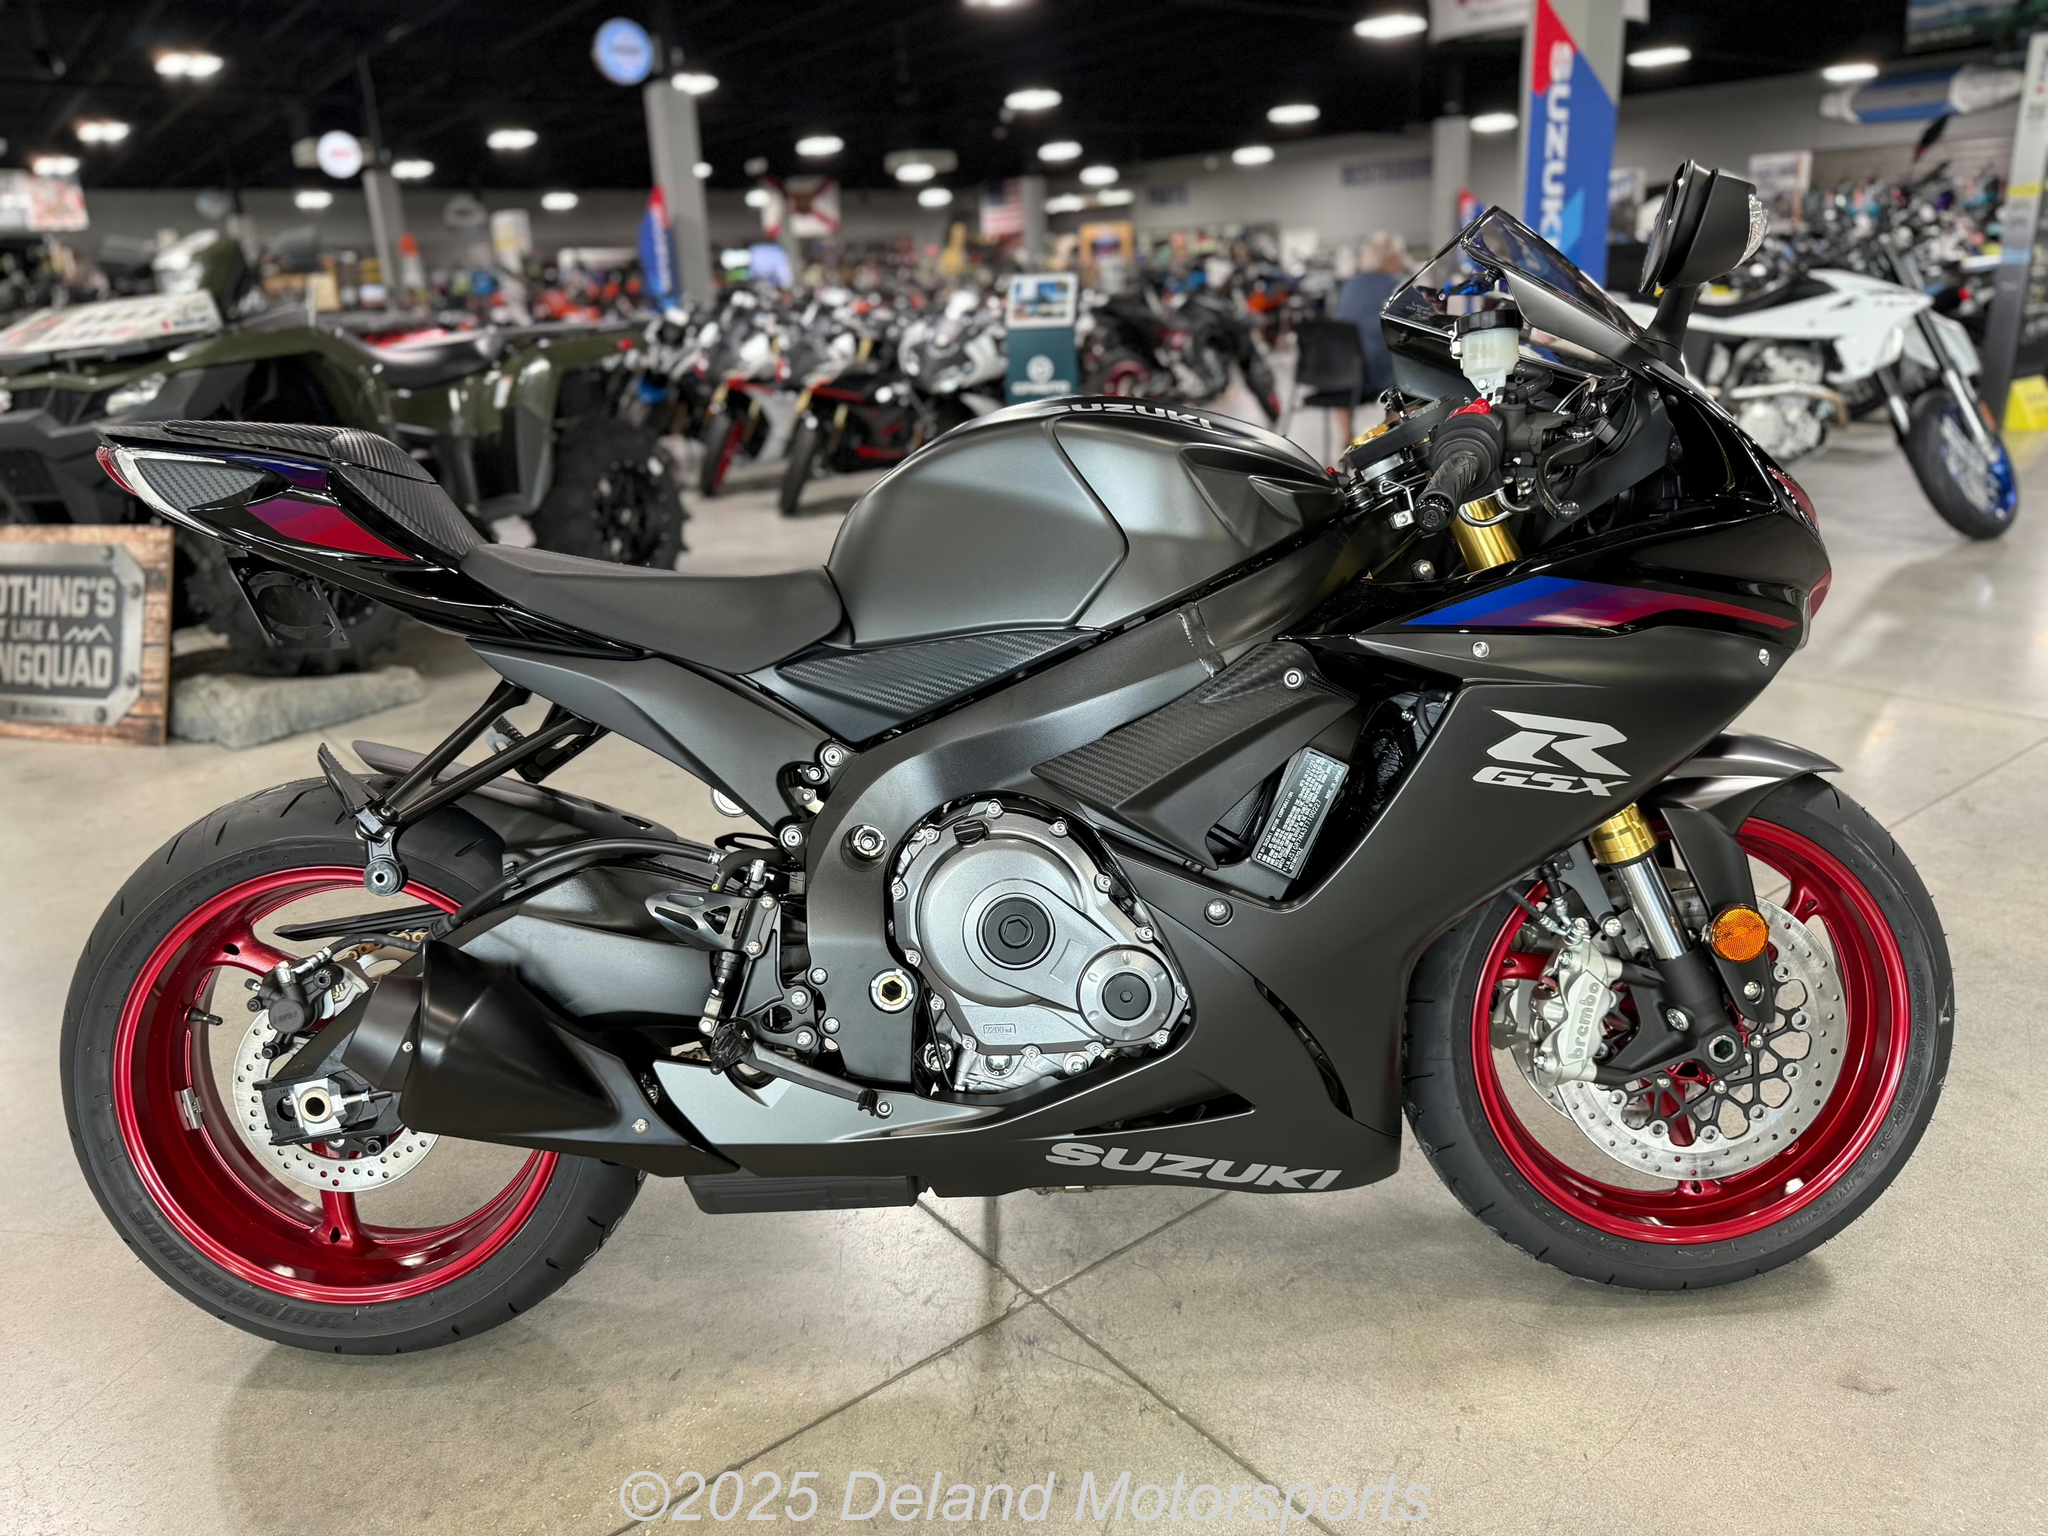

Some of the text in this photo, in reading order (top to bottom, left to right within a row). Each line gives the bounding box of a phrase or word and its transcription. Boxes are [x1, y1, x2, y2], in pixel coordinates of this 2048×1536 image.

[1038, 402, 1212, 430] SUZUKI
[10, 619, 45, 641] LIKE
[46, 621, 61, 641] A
[1487, 709, 1631, 777] R
[1472, 766, 1629, 797] GSX
[1045, 1142, 1342, 1189] SUZUKI
